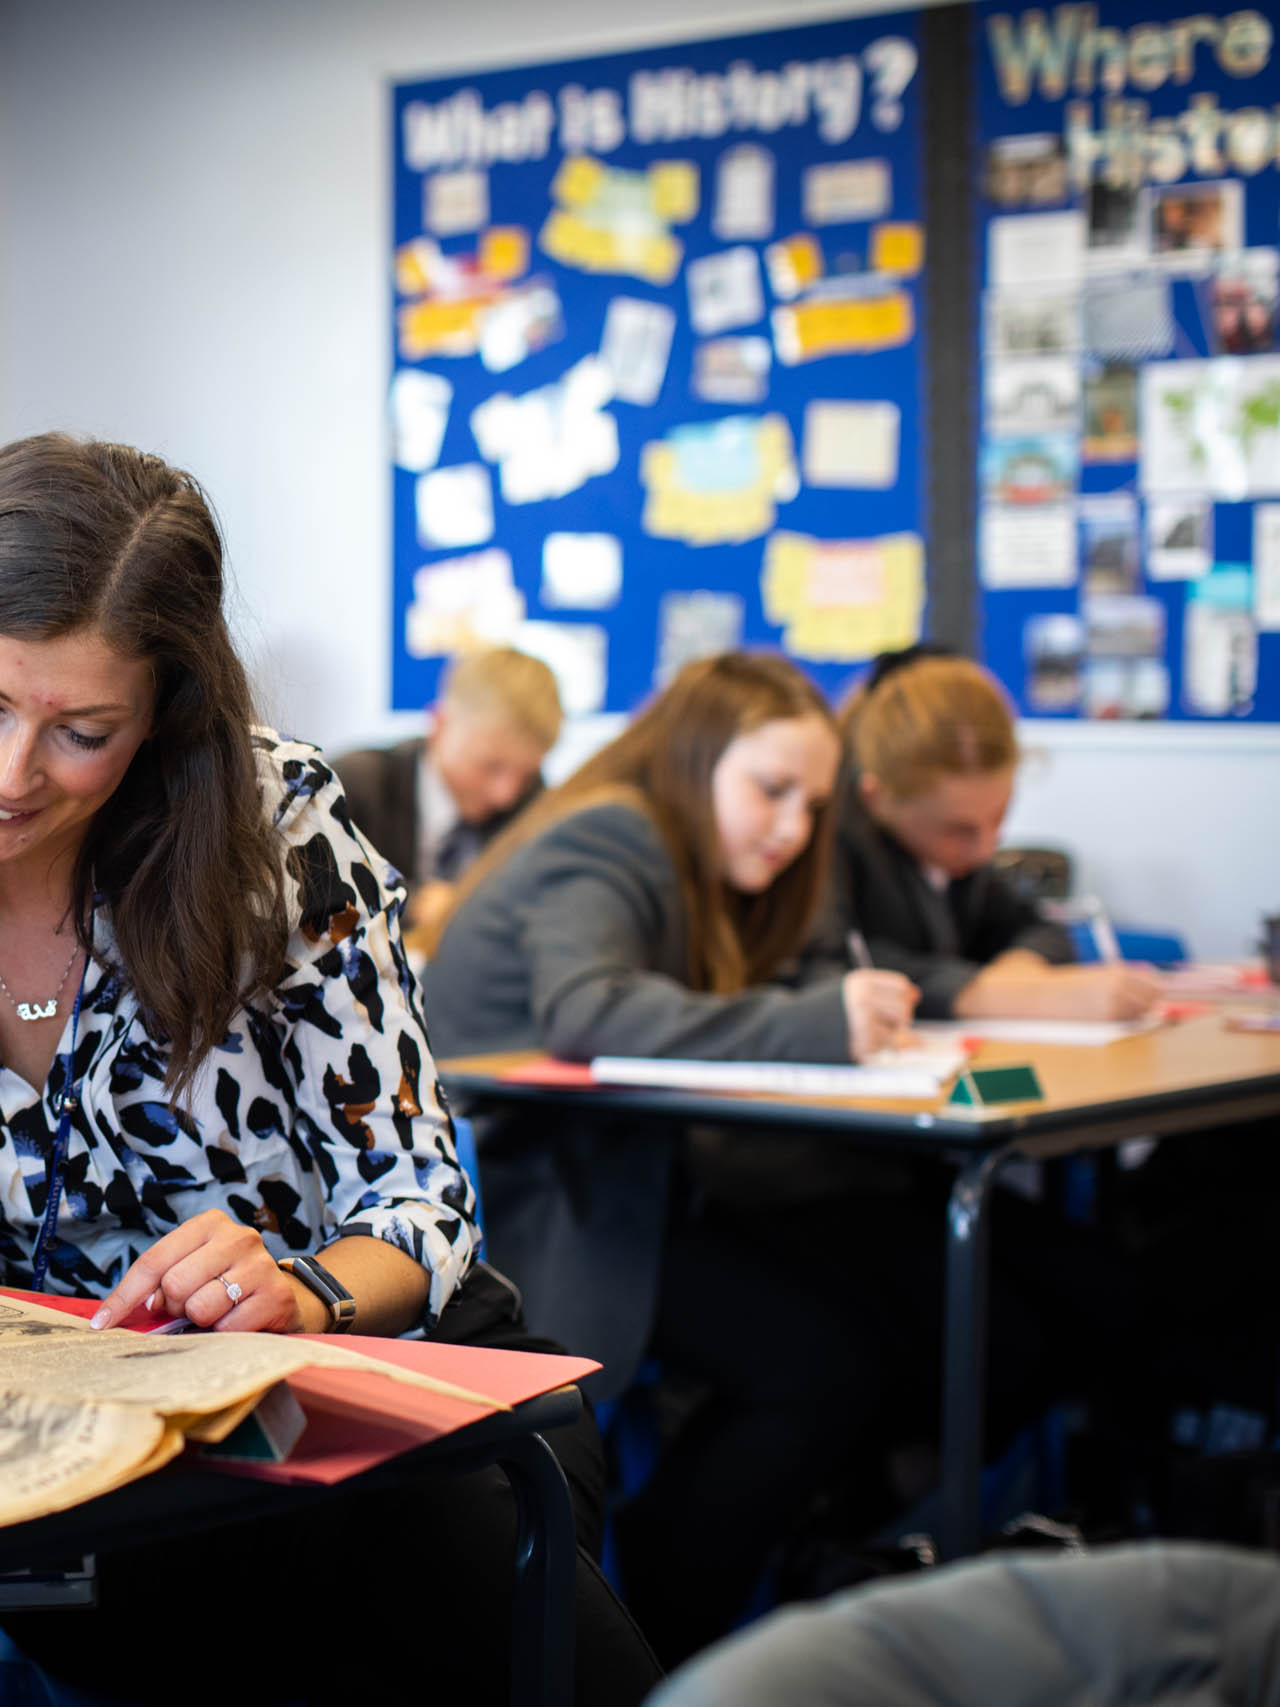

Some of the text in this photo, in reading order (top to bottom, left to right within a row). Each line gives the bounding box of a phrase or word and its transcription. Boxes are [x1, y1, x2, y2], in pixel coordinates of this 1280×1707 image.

[404, 89, 552, 171] What
[629, 37, 918, 144] History?
[987, 3, 1273, 106] Where
[1064, 93, 1280, 190] Histo
